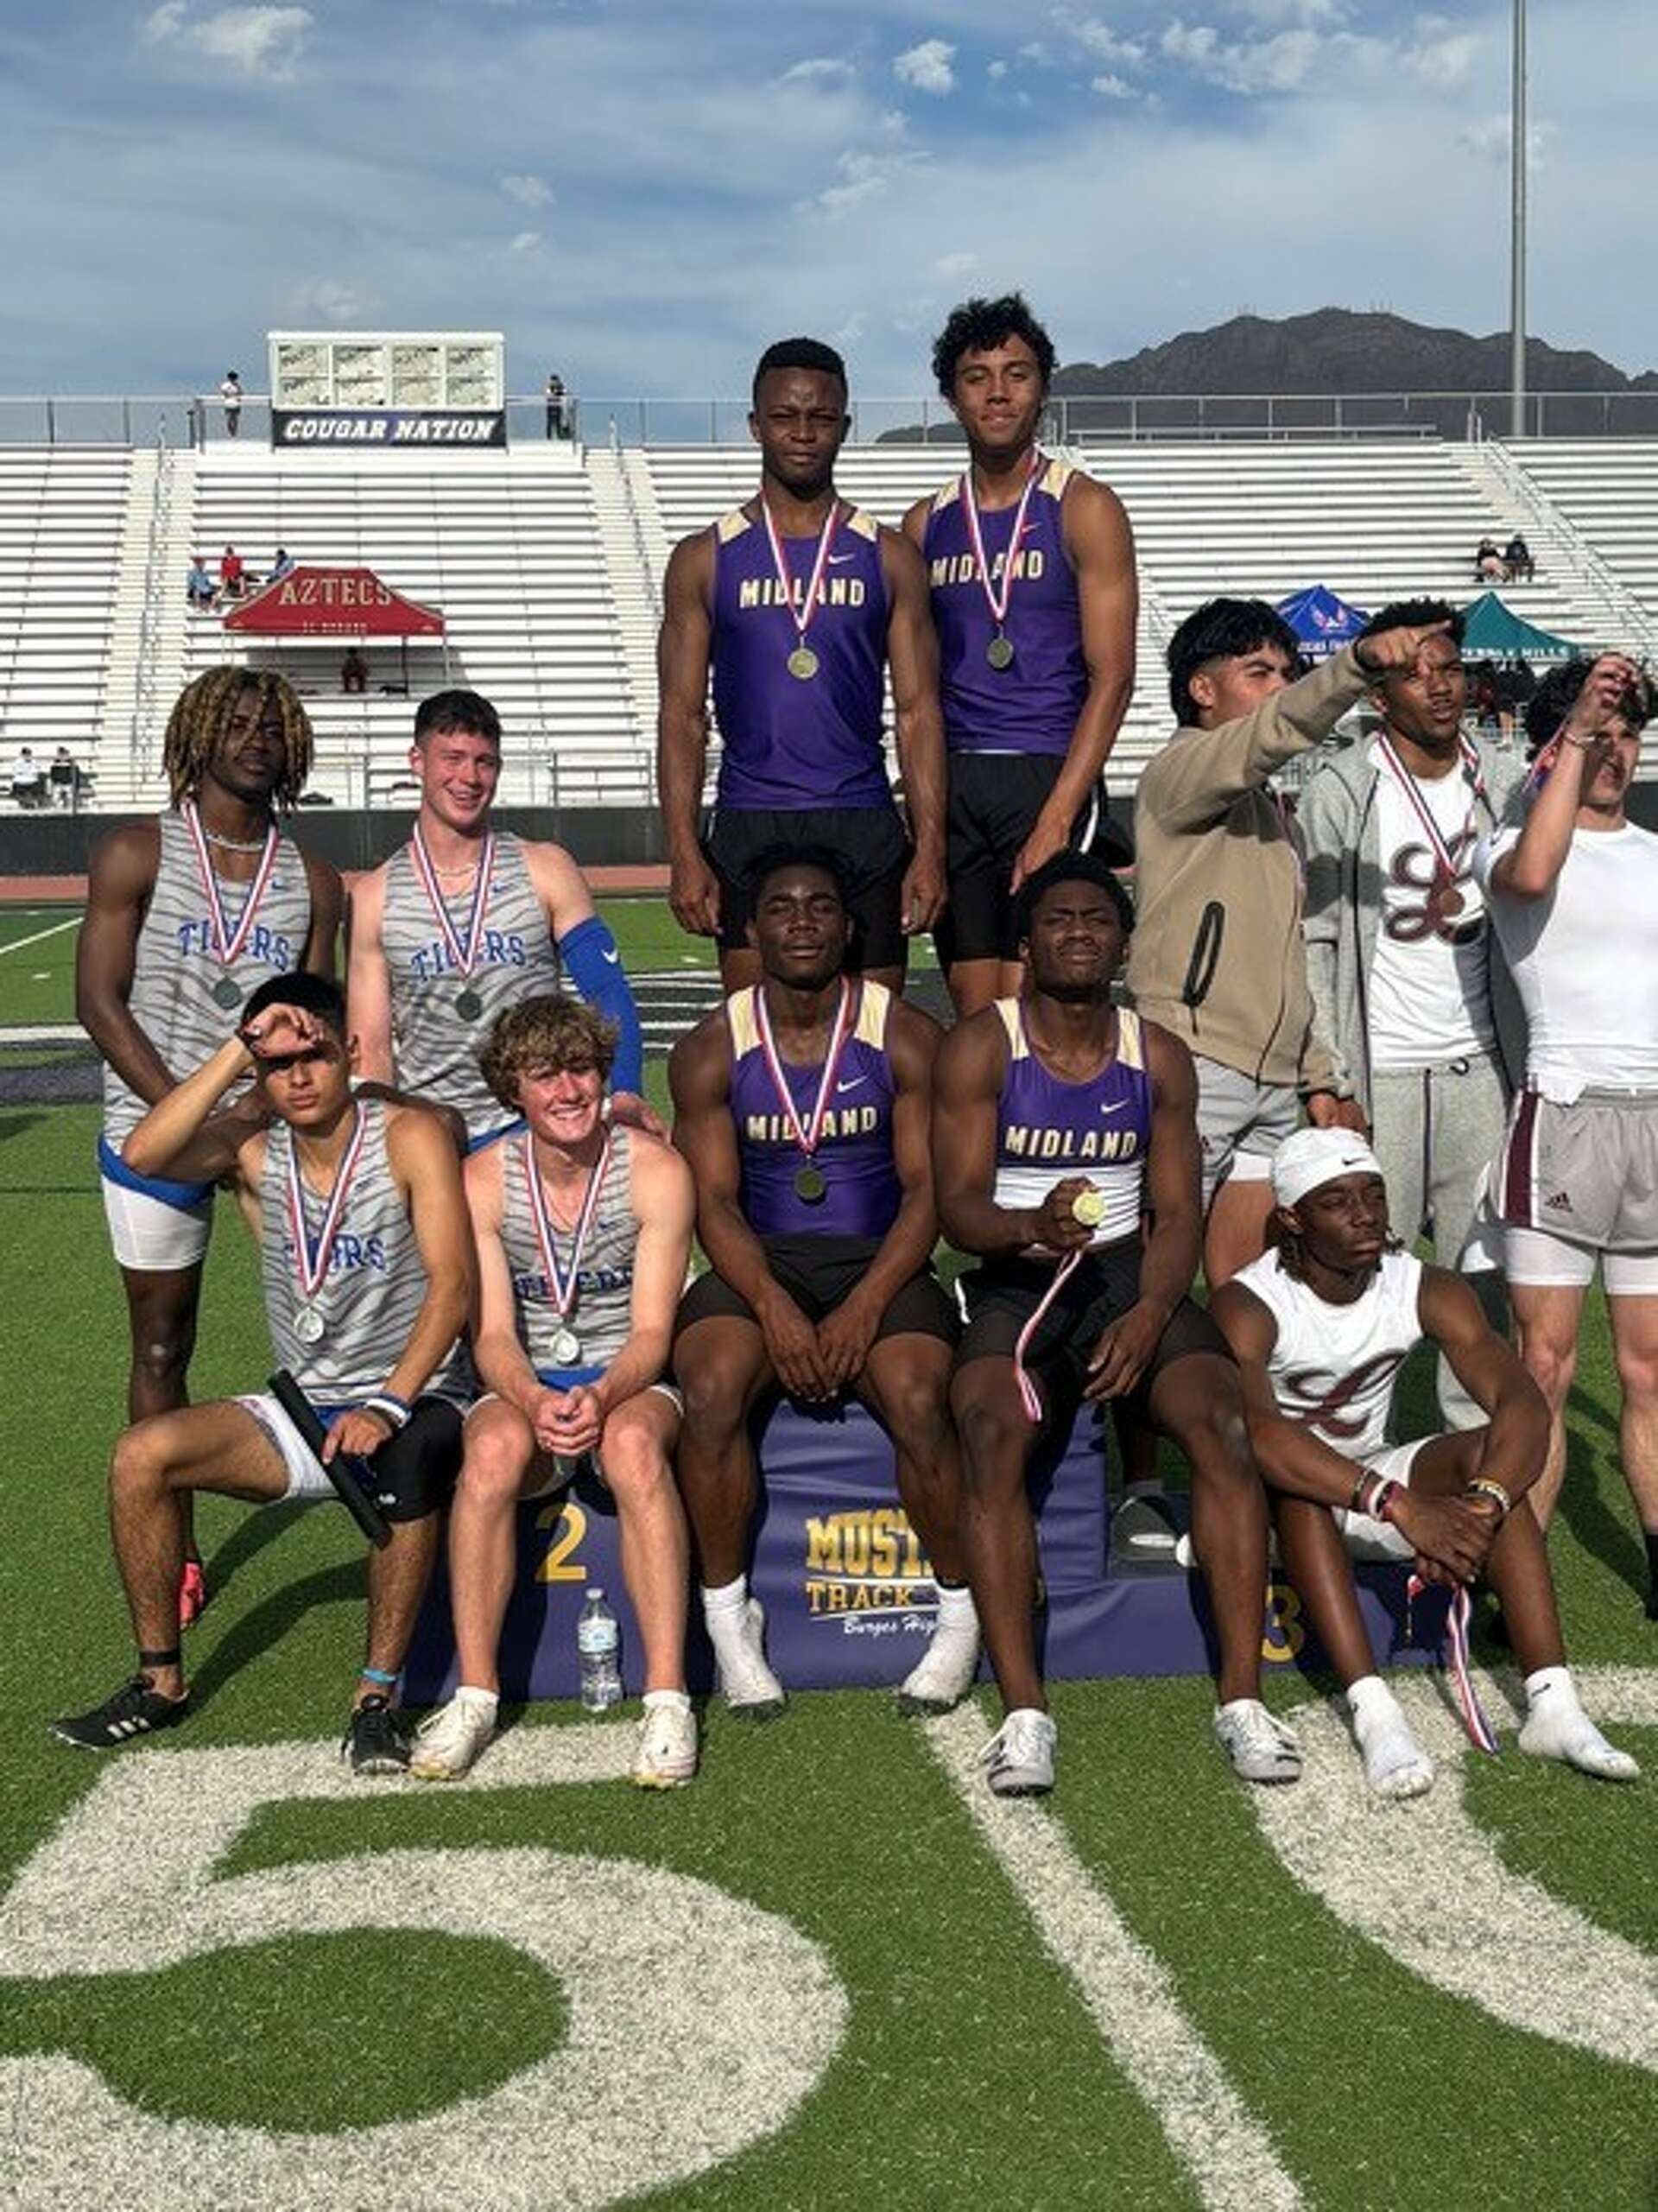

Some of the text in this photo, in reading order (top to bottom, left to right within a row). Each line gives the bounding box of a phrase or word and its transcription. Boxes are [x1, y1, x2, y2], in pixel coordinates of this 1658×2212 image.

[284, 420, 497, 440] COUGAR NATION
[279, 578, 392, 605] AZTECS
[1005, 1125, 1138, 1159] MIDLAND
[535, 1501, 587, 1581] 2
[806, 1581, 913, 1613] TRACK
[1262, 1584, 1305, 1663] 3
